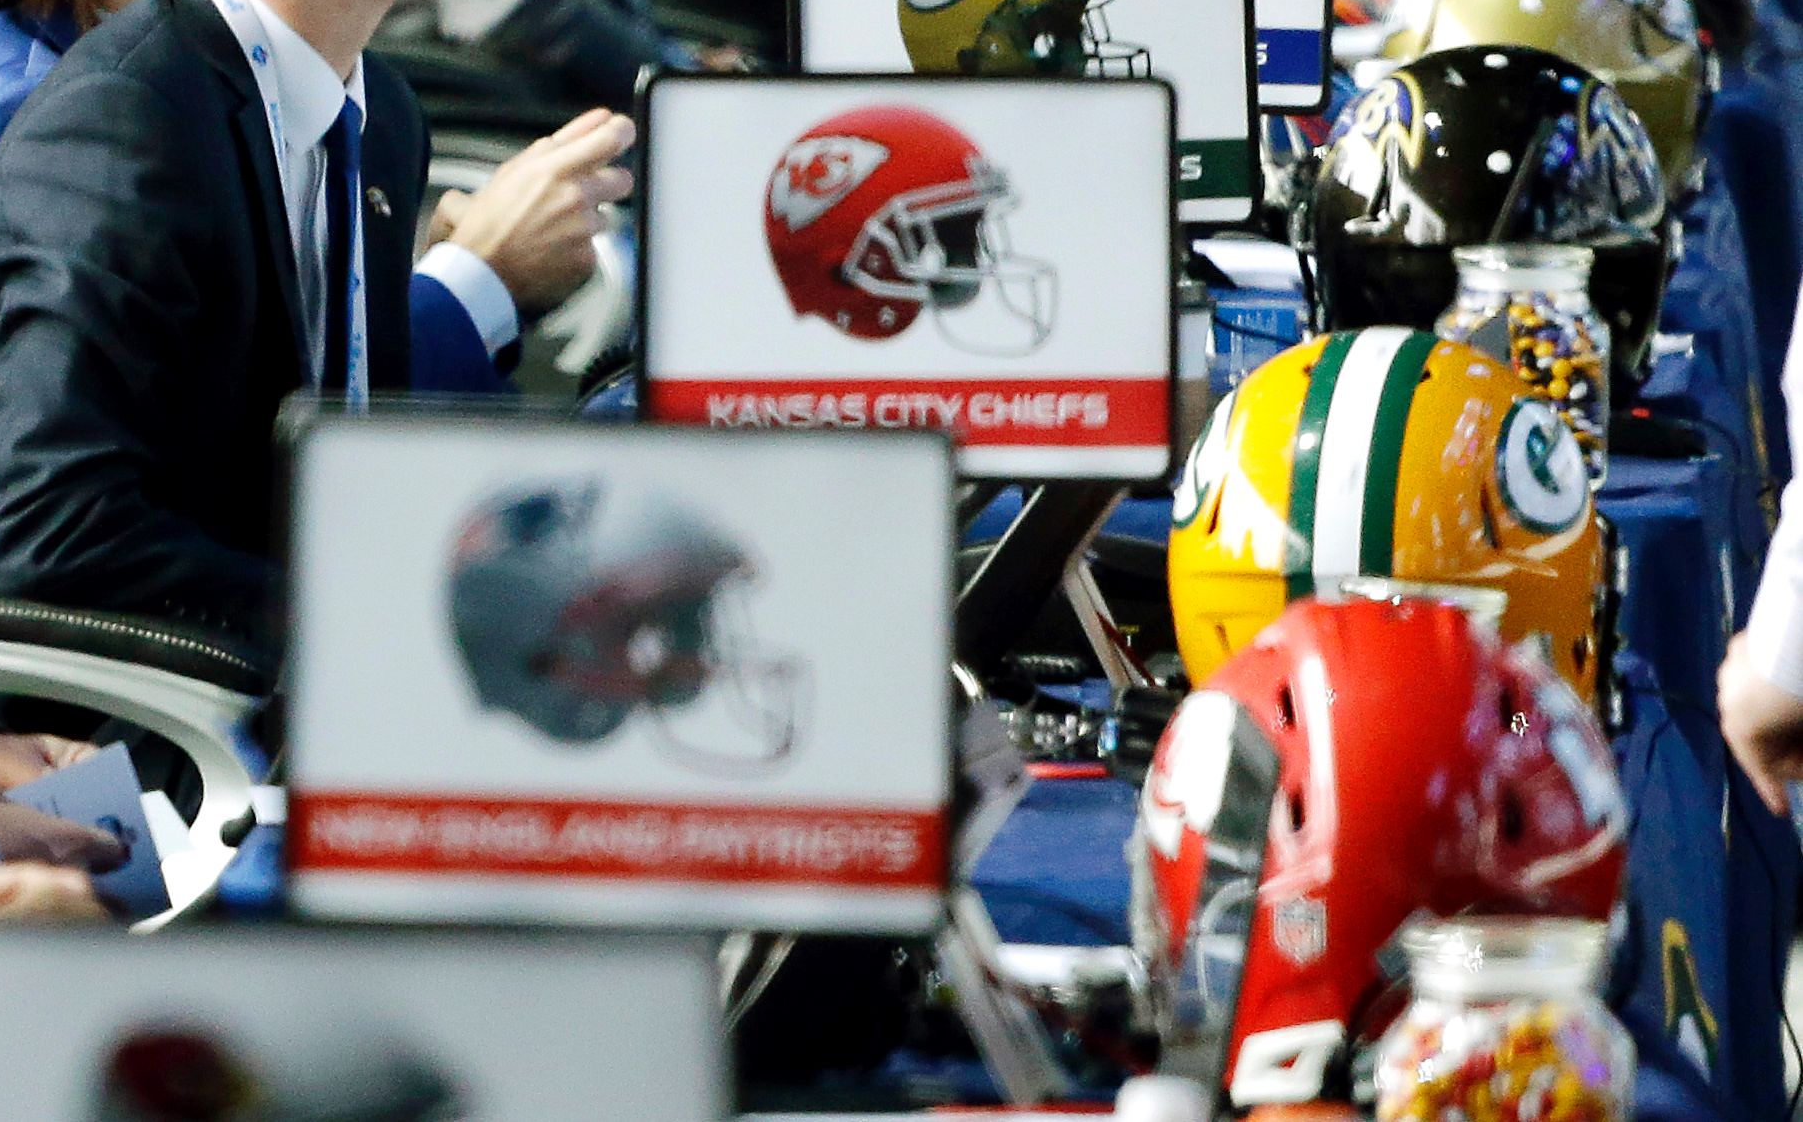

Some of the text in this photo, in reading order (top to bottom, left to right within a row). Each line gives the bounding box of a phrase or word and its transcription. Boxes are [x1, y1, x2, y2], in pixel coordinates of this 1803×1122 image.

[708, 392, 1110, 430] KANSAS CITY CHIEFS
